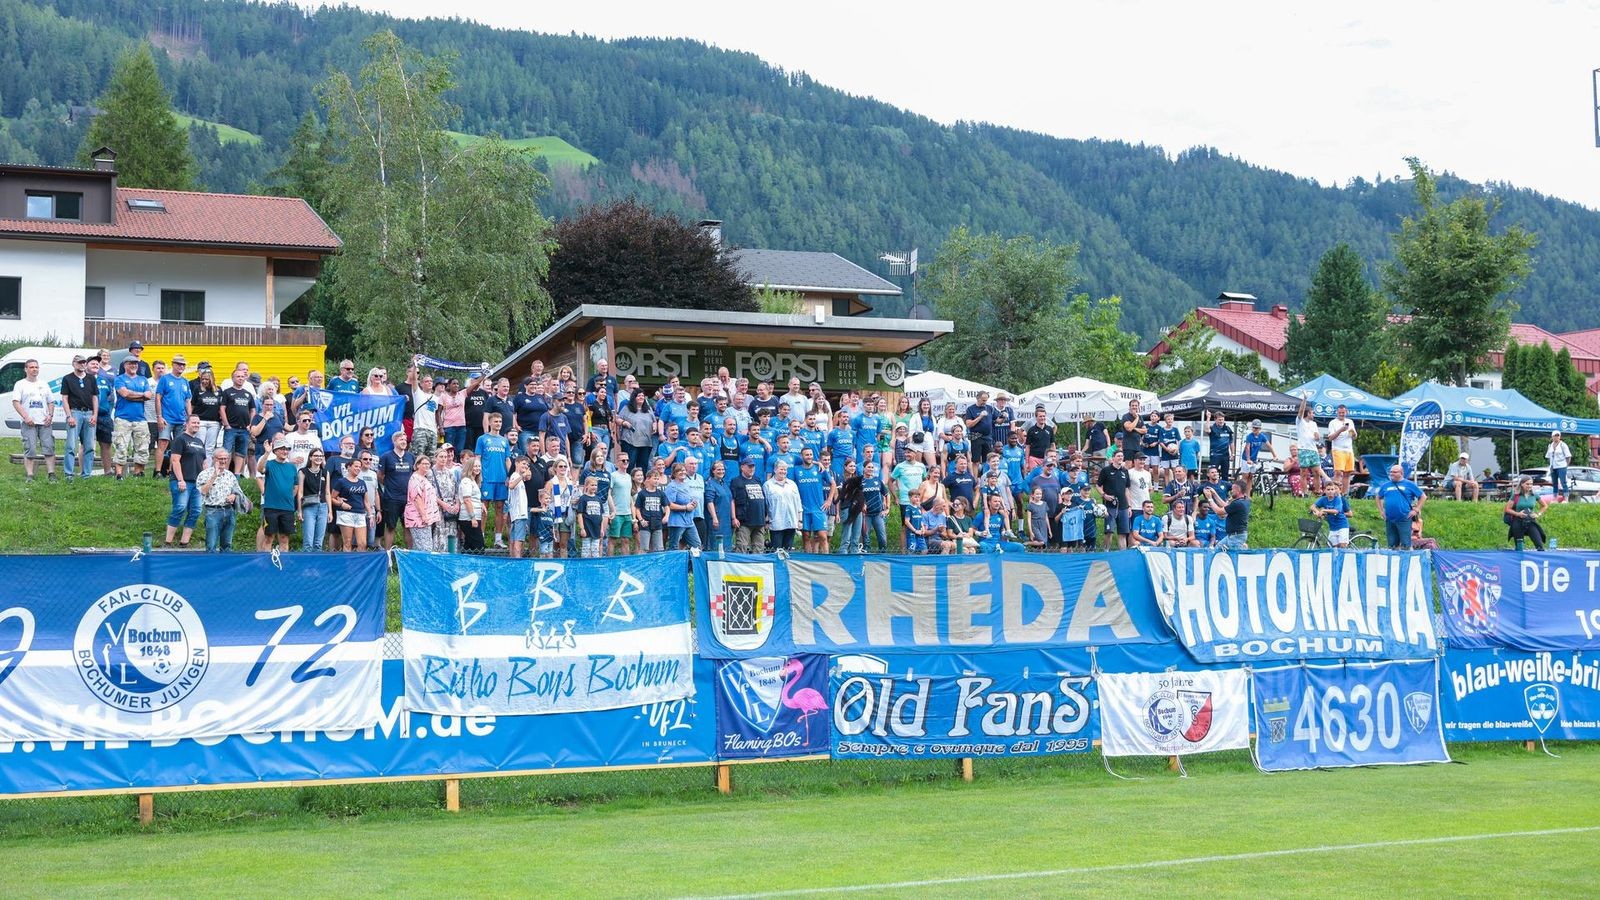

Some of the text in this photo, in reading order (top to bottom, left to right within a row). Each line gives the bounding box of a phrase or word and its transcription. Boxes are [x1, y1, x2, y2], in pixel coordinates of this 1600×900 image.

[614, 346, 696, 378] ORST
[735, 352, 832, 383] FORST
[838, 354, 857, 362] BIRRA
[1058, 391, 1087, 399] VELTINS
[1120, 392, 1142, 400] VELTINS
[321, 403, 397, 442] BOCHUM
[333, 402, 354, 419] VfL
[1409, 419, 1441, 430] TREFF
[1520, 559, 1570, 593] Die
[98, 587, 184, 615] FAN-CLUB
[452, 561, 645, 636] B B B
[785, 559, 1141, 646] RHEDA
[1145, 550, 1437, 650] PHOTOMAFIA
[128, 628, 182, 644] Bochum
[246, 604, 359, 687] 72
[525, 619, 577, 652] 1848
[1213, 637, 1383, 657] BOCHUM
[139, 645, 171, 657] 1848
[78, 648, 206, 709] BOCHUMER JUNGEN
[421, 650, 681, 705] Bistro Boys Bochum
[749, 664, 781, 678] Bochum
[759, 676, 777, 688] 1848
[1158, 680, 1170, 690] 50
[1451, 650, 1600, 702] blau-weiße-bri
[833, 675, 931, 738] Old
[1292, 681, 1401, 753] 4630
[1445, 720, 1456, 729] wir
[1458, 720, 1482, 731] tragen
[1482, 720, 1494, 729] die
[1495, 719, 1534, 729] blau-weiße
[1573, 720, 1596, 728] hinaus
[724, 731, 802, 754] FlamingBOs
[837, 738, 1088, 756] Sempre e ovunque dal 1995
